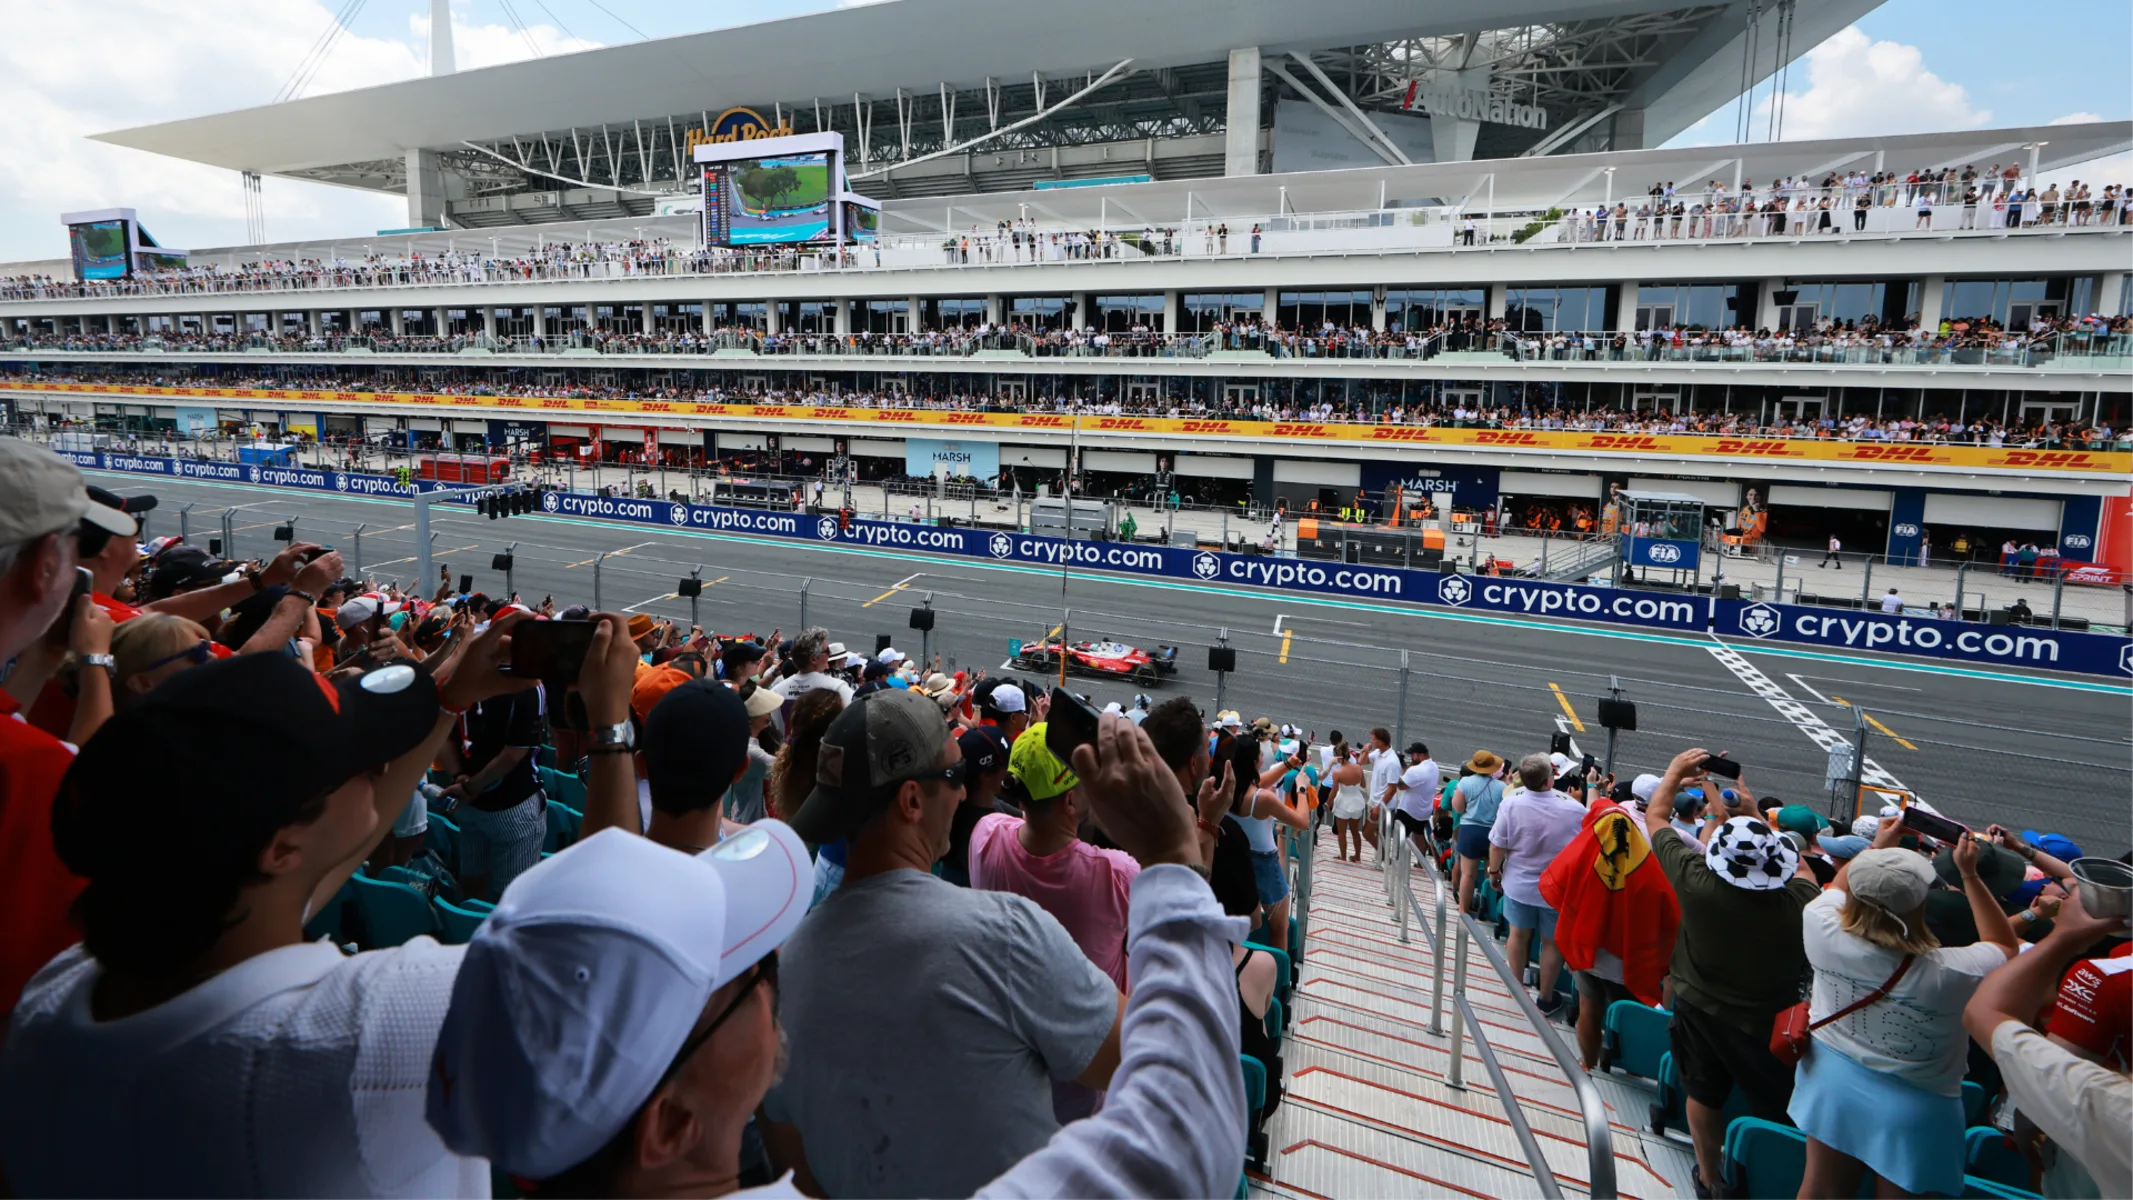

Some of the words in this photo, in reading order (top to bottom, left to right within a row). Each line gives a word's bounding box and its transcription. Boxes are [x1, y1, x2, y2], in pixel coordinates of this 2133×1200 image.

[1412, 81, 1547, 130] AutoNation
[687, 124, 738, 155] Hard
[375, 394, 396, 402] DHL
[413, 395, 436, 403] DHL
[455, 397, 478, 405] DHL
[498, 398, 522, 406] DHL
[543, 400, 569, 408] DHL
[642, 403, 671, 412] DHL
[696, 405, 727, 414] DHL
[753, 407, 786, 416] DHL
[813, 409, 849, 418] DHL
[878, 411, 916, 421] DHL
[946, 413, 986, 423] DHL
[1021, 416, 1064, 426] DHL
[1100, 419, 1145, 430] DHL
[1182, 421, 1232, 433] DHL
[1273, 424, 1327, 437] DHL
[504, 428, 529, 437] MARSH
[1372, 428, 1430, 441] DHL
[1475, 431, 1539, 445] DHL
[1589, 436, 1658, 450] DHL
[1716, 440, 1792, 455] DHL
[933, 451, 971, 463] MARSH
[1854, 446, 1936, 462] DHL
[2004, 451, 2096, 468] DHL
[114, 456, 164, 472] crypto.com
[185, 462, 240, 479] crypto.com
[263, 469, 324, 487] crypto.com
[351, 478, 420, 495] crypto.com
[1401, 478, 1457, 493] MARSH
[563, 497, 652, 519] crypto.com
[693, 509, 796, 533] crypto.com
[844, 523, 964, 549] crypto.com
[1895, 525, 1918, 536] FIA
[2065, 536, 2090, 548] FIA
[1020, 540, 1162, 570] crypto.com
[1652, 546, 1679, 562] FIA
[1230, 559, 1401, 593] crypto.com
[2068, 572, 2113, 583] SPRINT
[1484, 582, 1693, 623] crypto.com
[1796, 613, 2059, 662] crypto.com
[2077, 968, 2102, 986] aws
[2063, 978, 2096, 1002] DXC
